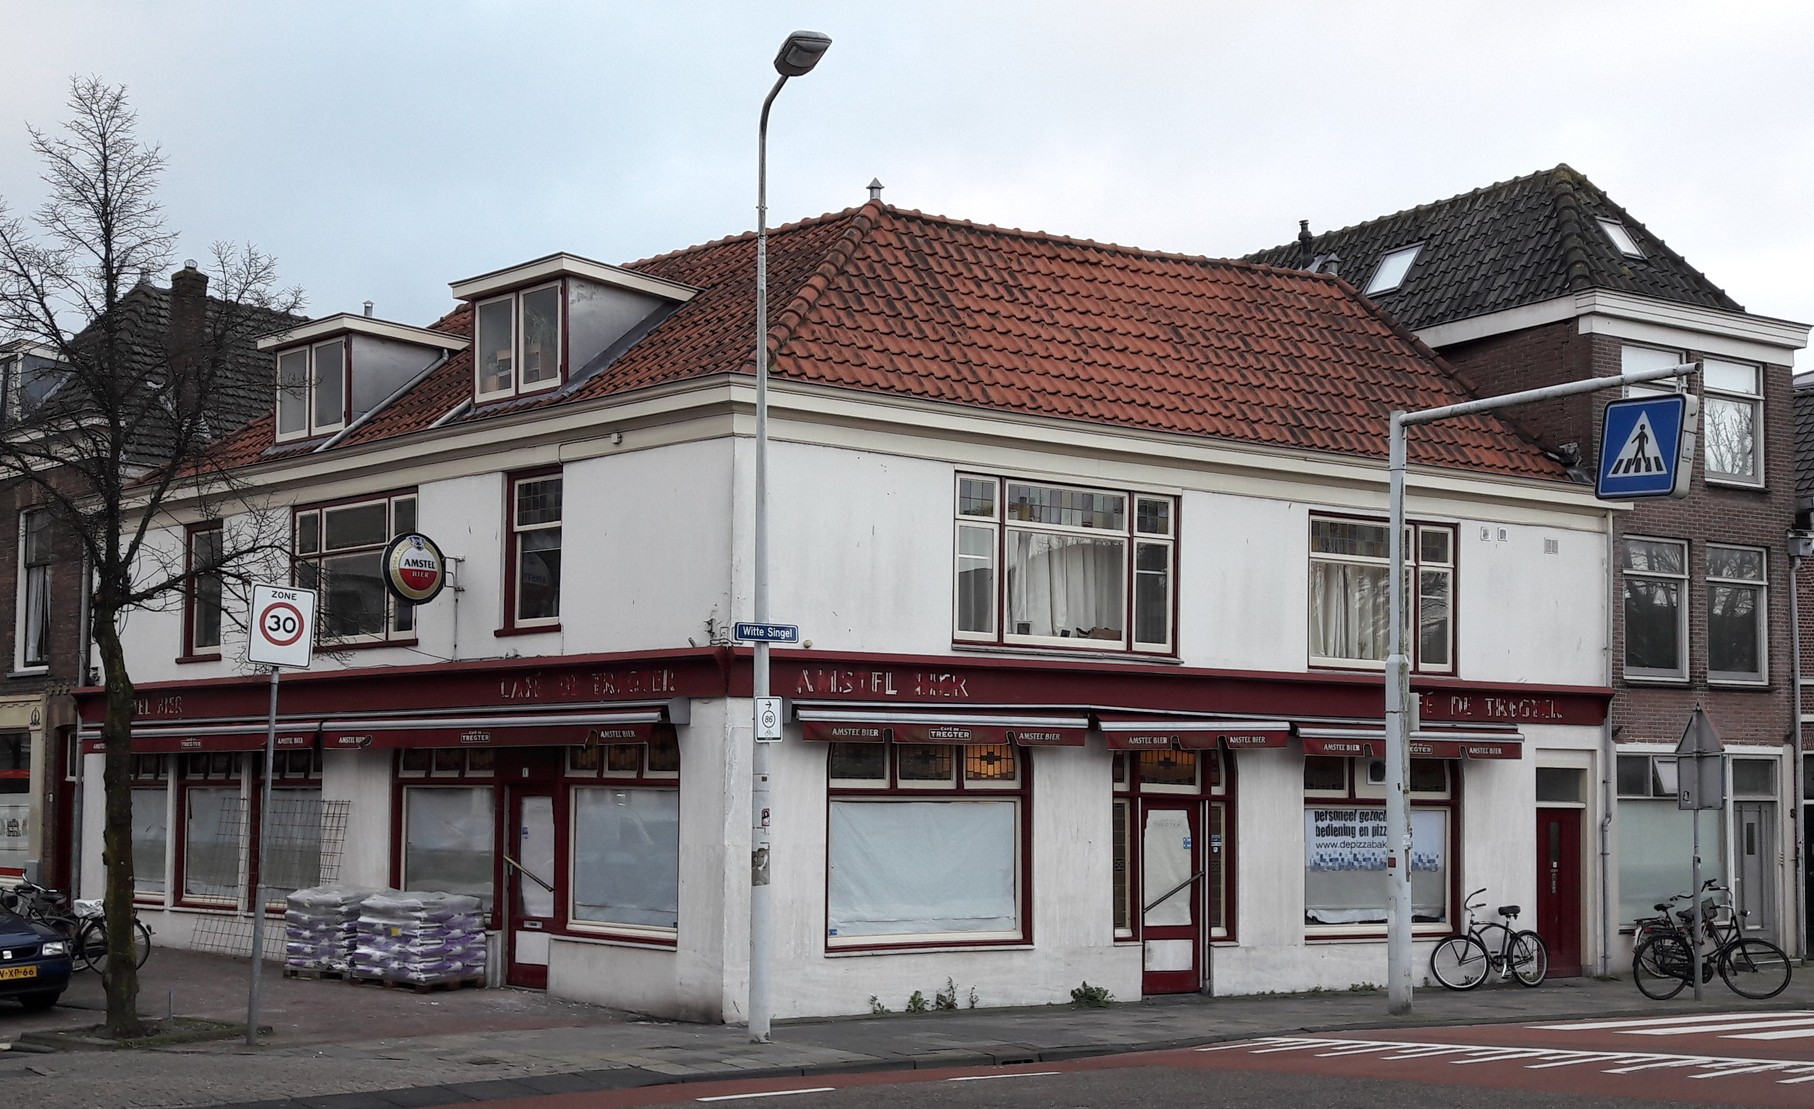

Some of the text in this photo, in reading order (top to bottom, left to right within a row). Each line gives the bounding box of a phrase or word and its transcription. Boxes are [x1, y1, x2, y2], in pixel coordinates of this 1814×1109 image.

[404, 558, 436, 570] AMSTEL
[412, 571, 430, 579] BIER
[271, 590, 298, 601] ZONE
[267, 614, 297, 634] 30
[743, 626, 793, 639] Witte Singel
[764, 715, 774, 724] 86
[600, 730, 636, 738] AMSTEL BIER
[832, 728, 879, 737] AMSTEL BIER
[1019, 732, 1060, 741] AMSTEL BIER
[1323, 743, 1345, 751] AMSTEL
[1315, 824, 1388, 838] bediening en pizz
[1315, 840, 1388, 850] www.depizzabak
